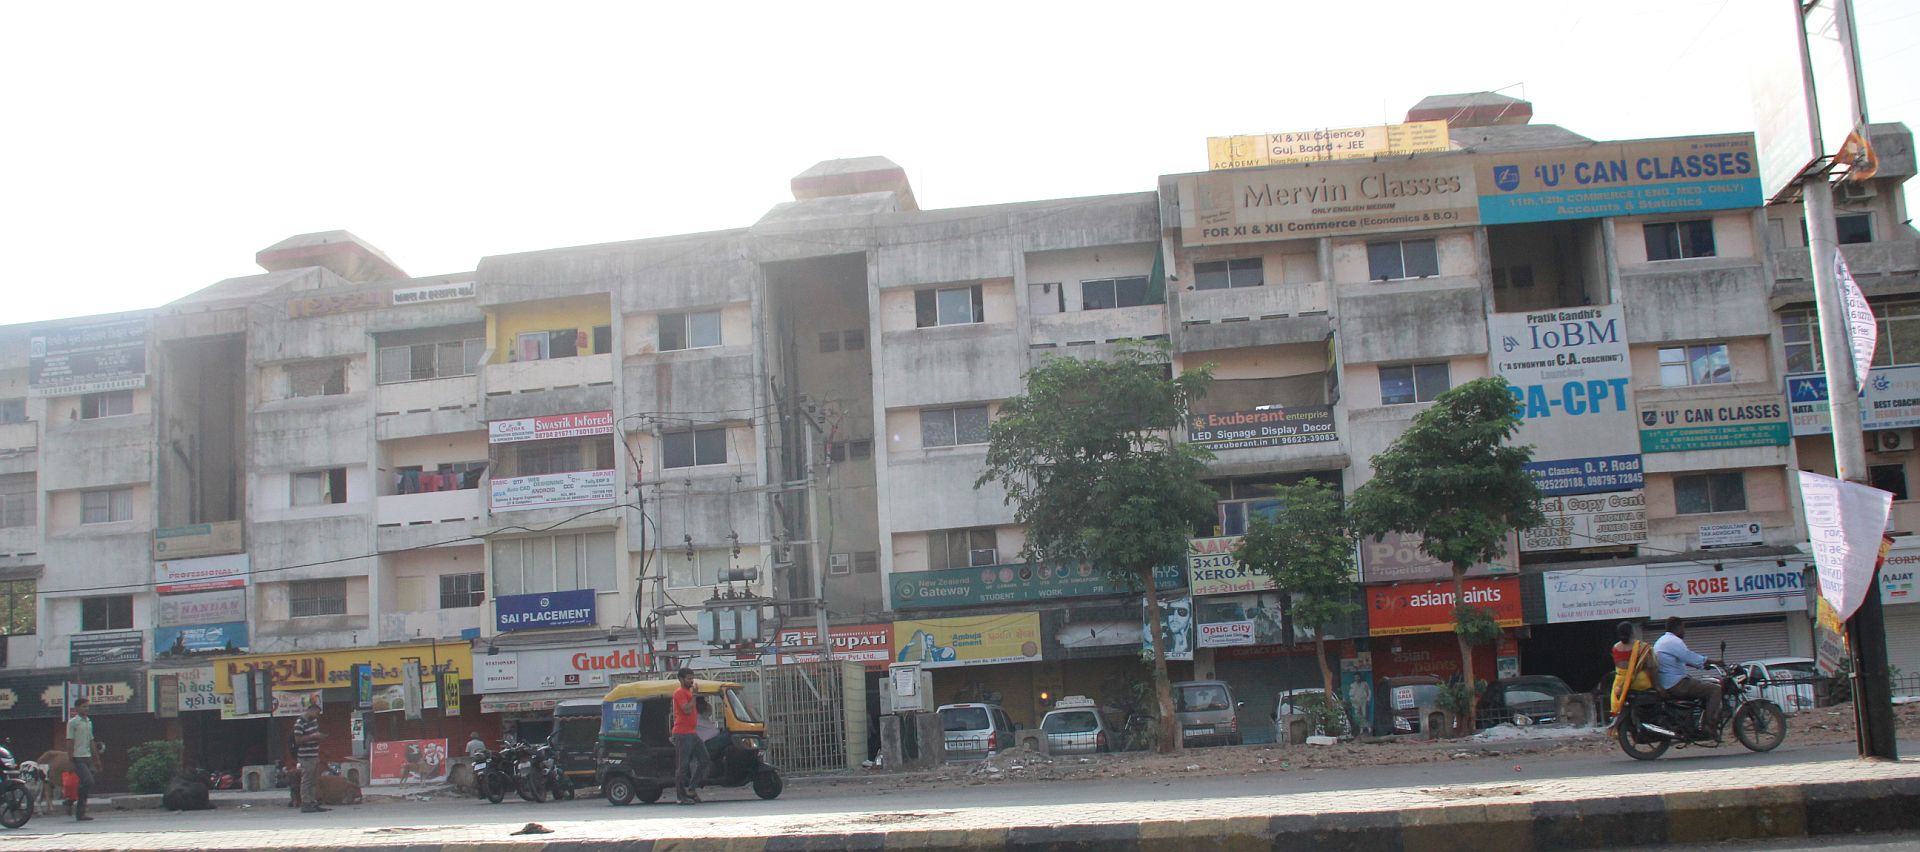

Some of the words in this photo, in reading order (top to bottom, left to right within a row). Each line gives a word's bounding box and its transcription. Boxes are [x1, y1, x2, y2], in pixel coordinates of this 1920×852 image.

[1272, 135, 1282, 144] XI
[1286, 134, 1292, 142] &
[1296, 133, 1309, 142] XII
[1313, 129, 1365, 141] (Science)
[1272, 146, 1295, 155] Guj.
[1299, 143, 1333, 153] Board
[1347, 141, 1364, 150] JEE
[1214, 159, 1260, 169] ACADEMY
[1574, 159, 1628, 185] CAN
[1636, 151, 1751, 180] CLASSES
[1244, 177, 1347, 208] Mervin
[1360, 172, 1461, 200] Classes
[1567, 190, 1633, 202] COMMERCE
[1332, 205, 1365, 213] ENGLISH
[1366, 202, 1396, 211] MEDIUM
[1557, 203, 1620, 215] Accounts
[1639, 198, 1703, 209] Statistics
[1202, 227, 1229, 238] FOR
[1233, 226, 1246, 235] XI
[1251, 225, 1261, 234] &
[1265, 223, 1283, 233] XII
[1287, 219, 1356, 232] Commerce
[1360, 215, 1420, 228] (Economics
[1527, 313, 1557, 324] Pratik
[1559, 309, 1602, 321] Gandhi's
[1528, 319, 1620, 350] IoBM
[1513, 360, 1546, 370] SYNONYM
[1547, 359, 1555, 367] OF
[1556, 352, 1580, 366] C.A.
[1505, 378, 1629, 421] CA-CPT
[1874, 400, 1891, 409] BEST
[1208, 410, 1286, 426] Exuberant
[1286, 410, 1329, 422] enterprise
[1684, 408, 1713, 423] CAN
[1718, 403, 1781, 421] CLASSES
[1191, 431, 1212, 441] LED
[1217, 427, 1257, 440] Signage
[1262, 425, 1298, 437] Display
[1302, 423, 1332, 432] Decor
[1282, 433, 1335, 444] 96623-39083
[1548, 467, 1583, 476] Classes,
[1584, 462, 1596, 473] O.
[1599, 461, 1608, 472] P.
[1611, 458, 1639, 471] Road
[1618, 472, 1643, 484] 72845
[1567, 497, 1606, 512] Copy
[1608, 494, 1646, 507] Cent
[1524, 526, 1573, 538] PRINT
[1596, 523, 1629, 533] JUMBO
[1527, 537, 1572, 548] SCAN
[1595, 533, 1632, 543] COLOUR
[1194, 567, 1247, 581] XEROX
[1371, 564, 1431, 577] Properties
[919, 579, 936, 587] New
[939, 577, 970, 586] Zealand
[1554, 579, 1596, 595] Easy
[1600, 576, 1638, 592] Way
[1687, 577, 1729, 596] ROBE
[1735, 571, 1806, 592] LAUNDRY
[919, 585, 970, 598] Gateway
[979, 592, 1014, 601] STUDENT
[1038, 588, 1062, 597] WORK
[1093, 585, 1104, 593] PR
[501, 613, 519, 624] SAI
[522, 608, 591, 622] PLACEMENT
[952, 632, 981, 641] Ambuja
[1202, 625, 1229, 637] Optic
[1231, 624, 1251, 635] City
[952, 639, 982, 647] Cement
[571, 649, 653, 671] Guddu
[92, 695, 125, 703] ELECTRONICS
